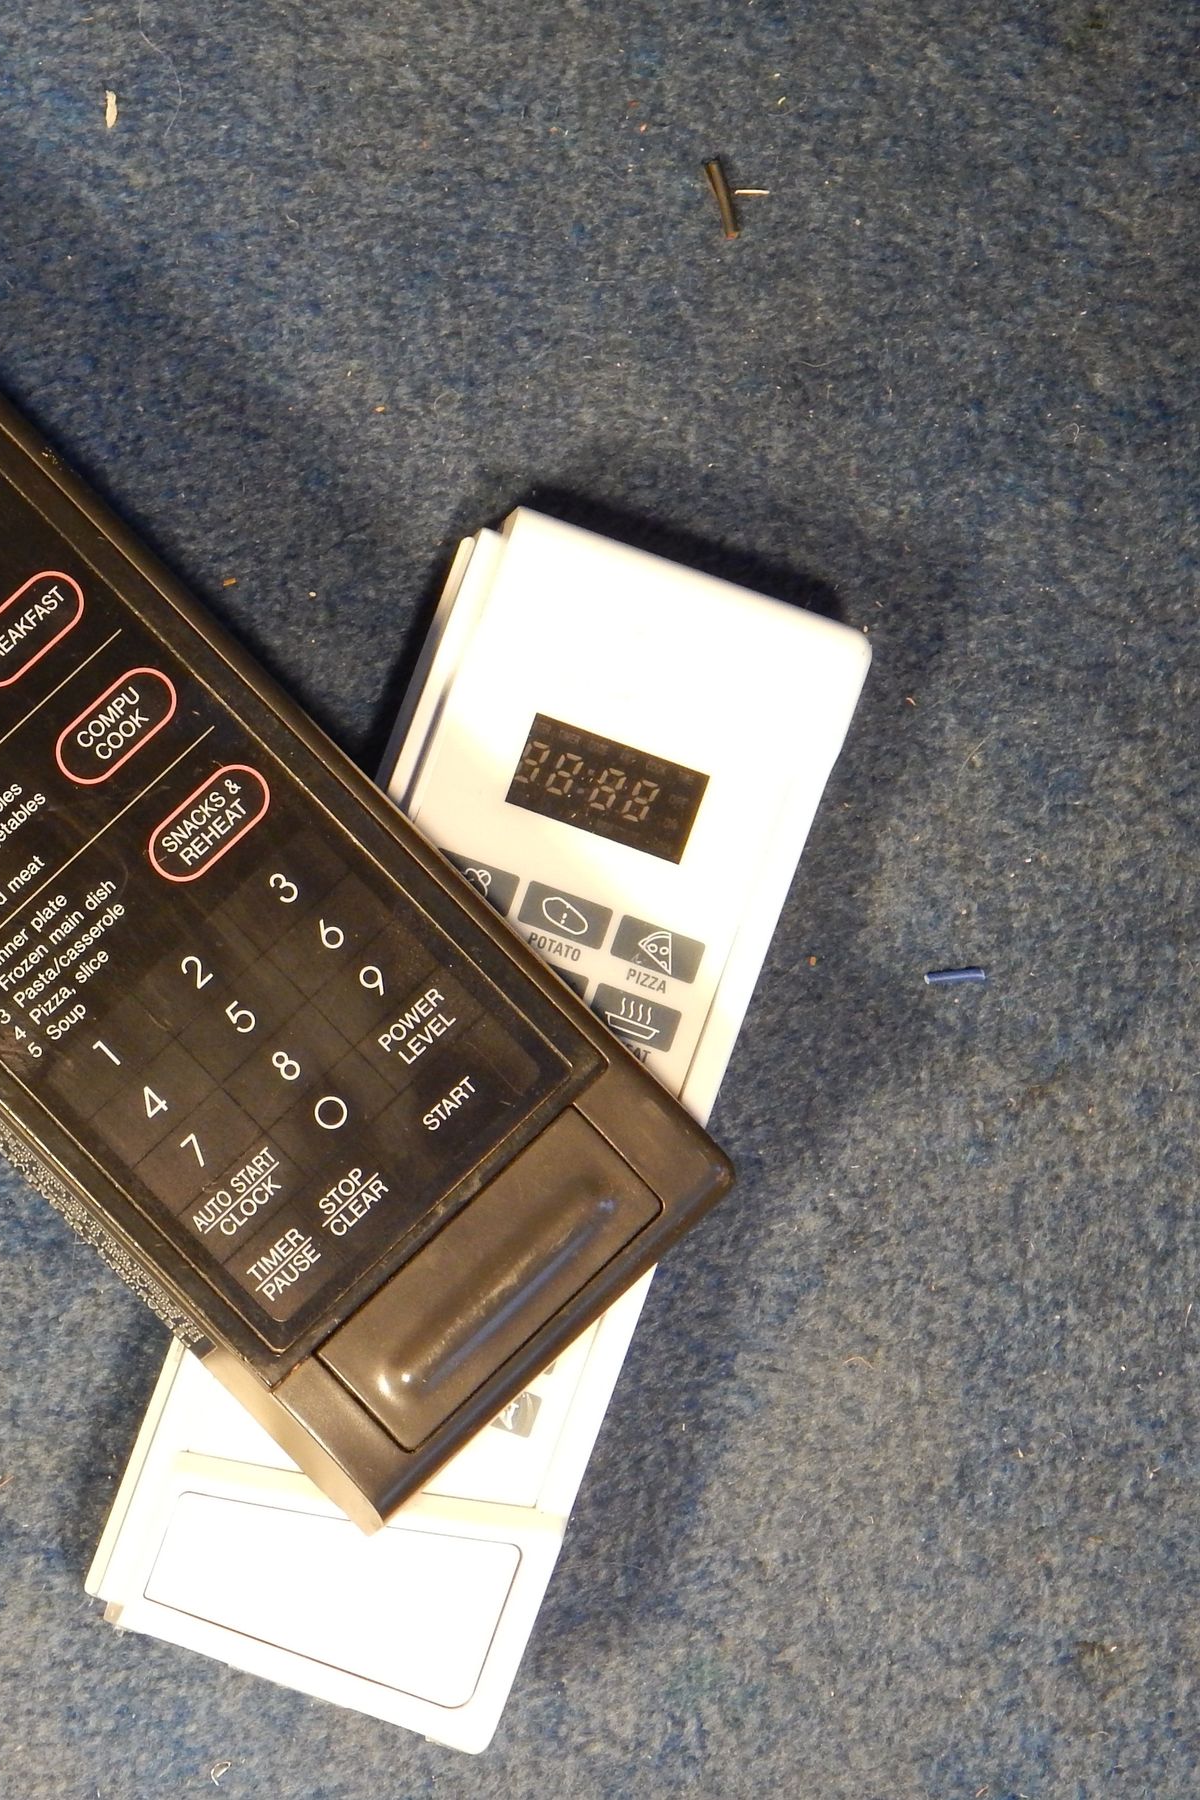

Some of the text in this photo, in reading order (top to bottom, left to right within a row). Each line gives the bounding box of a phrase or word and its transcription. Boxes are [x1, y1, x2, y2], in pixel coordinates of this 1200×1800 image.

[77, 686, 139, 747] COMPU
[96, 707, 149, 759] COOK
[162, 779, 241, 852] SNACKS &
[179, 797, 246, 865] REHEAT
[7, 855, 45, 892] meat
[30, 895, 67, 932] plate
[49, 911, 84, 944] main
[85, 881, 116, 910] dish
[13, 904, 124, 1008] Pasta/casserole
[92, 873, 298, 1065] 1 2 3
[527, 932, 582, 962] POTATO
[14, 951, 108, 1039] 4 Pizza, slice
[625, 967, 667, 994] PIZZA
[27, 1004, 86, 1057] 5 Soup
[143, 918, 344, 1118] 4 5 6
[378, 988, 445, 1052] POWER
[398, 1013, 456, 1064] LEVEL
[180, 965, 384, 1167] 7 8 9
[314, 1095, 347, 1129] 0
[423, 1076, 475, 1130] START
[192, 1146, 275, 1231] AUTO START
[212, 1175, 282, 1235] CLOCK
[319, 1167, 362, 1214] STOP
[330, 1179, 389, 1235] CLEAR
[246, 1228, 305, 1280] TIMER
[257, 1243, 321, 1301] PAUSE
